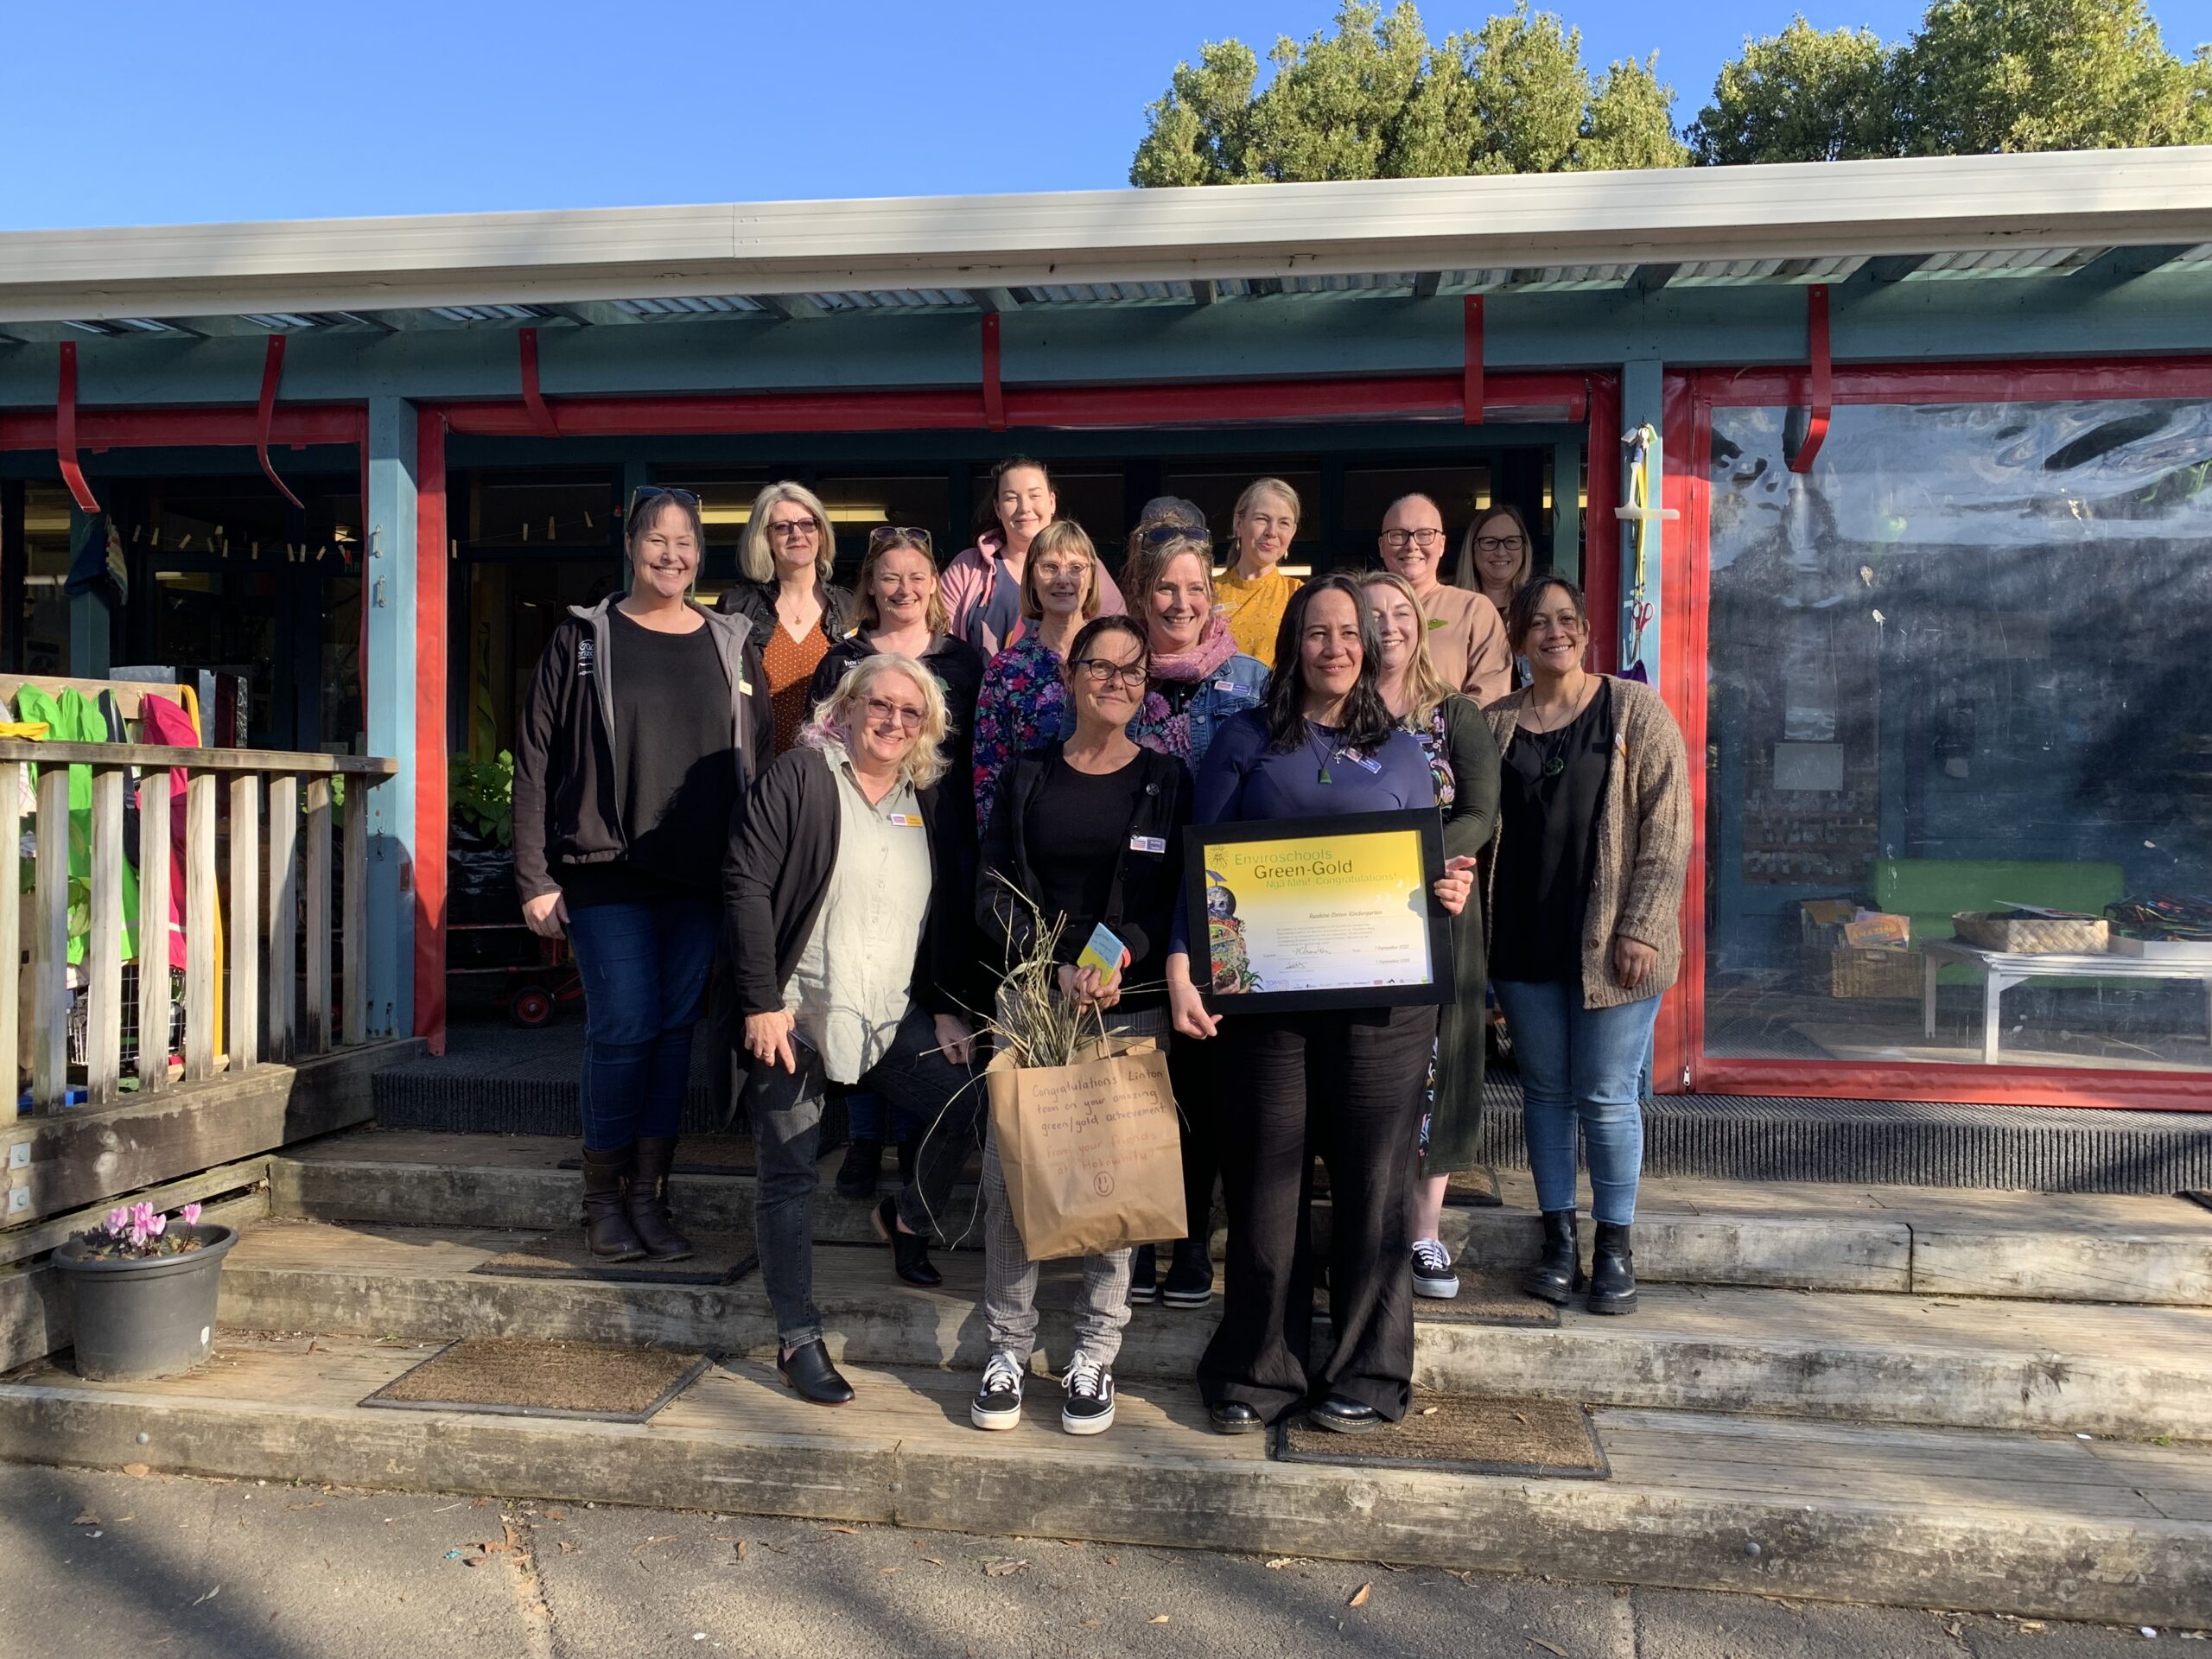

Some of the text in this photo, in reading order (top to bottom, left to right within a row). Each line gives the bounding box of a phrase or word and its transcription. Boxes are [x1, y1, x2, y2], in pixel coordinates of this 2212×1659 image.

[345, 562, 359, 574] FIR
[1234, 849, 1332, 865] Enviroschools
[1254, 860, 1352, 879] Green-Gold
[1315, 872, 1396, 887] Congratulations!
[1033, 1069, 1164, 1103] Congratulations Linton
[1037, 1104, 1059, 1114] team
[1084, 1098, 1106, 1116] your
[1113, 1090, 1159, 1104] amazing
[1041, 1115, 1099, 1137] green/gold
[1078, 1141, 1103, 1156] your
[1058, 1164, 1068, 1175] at
